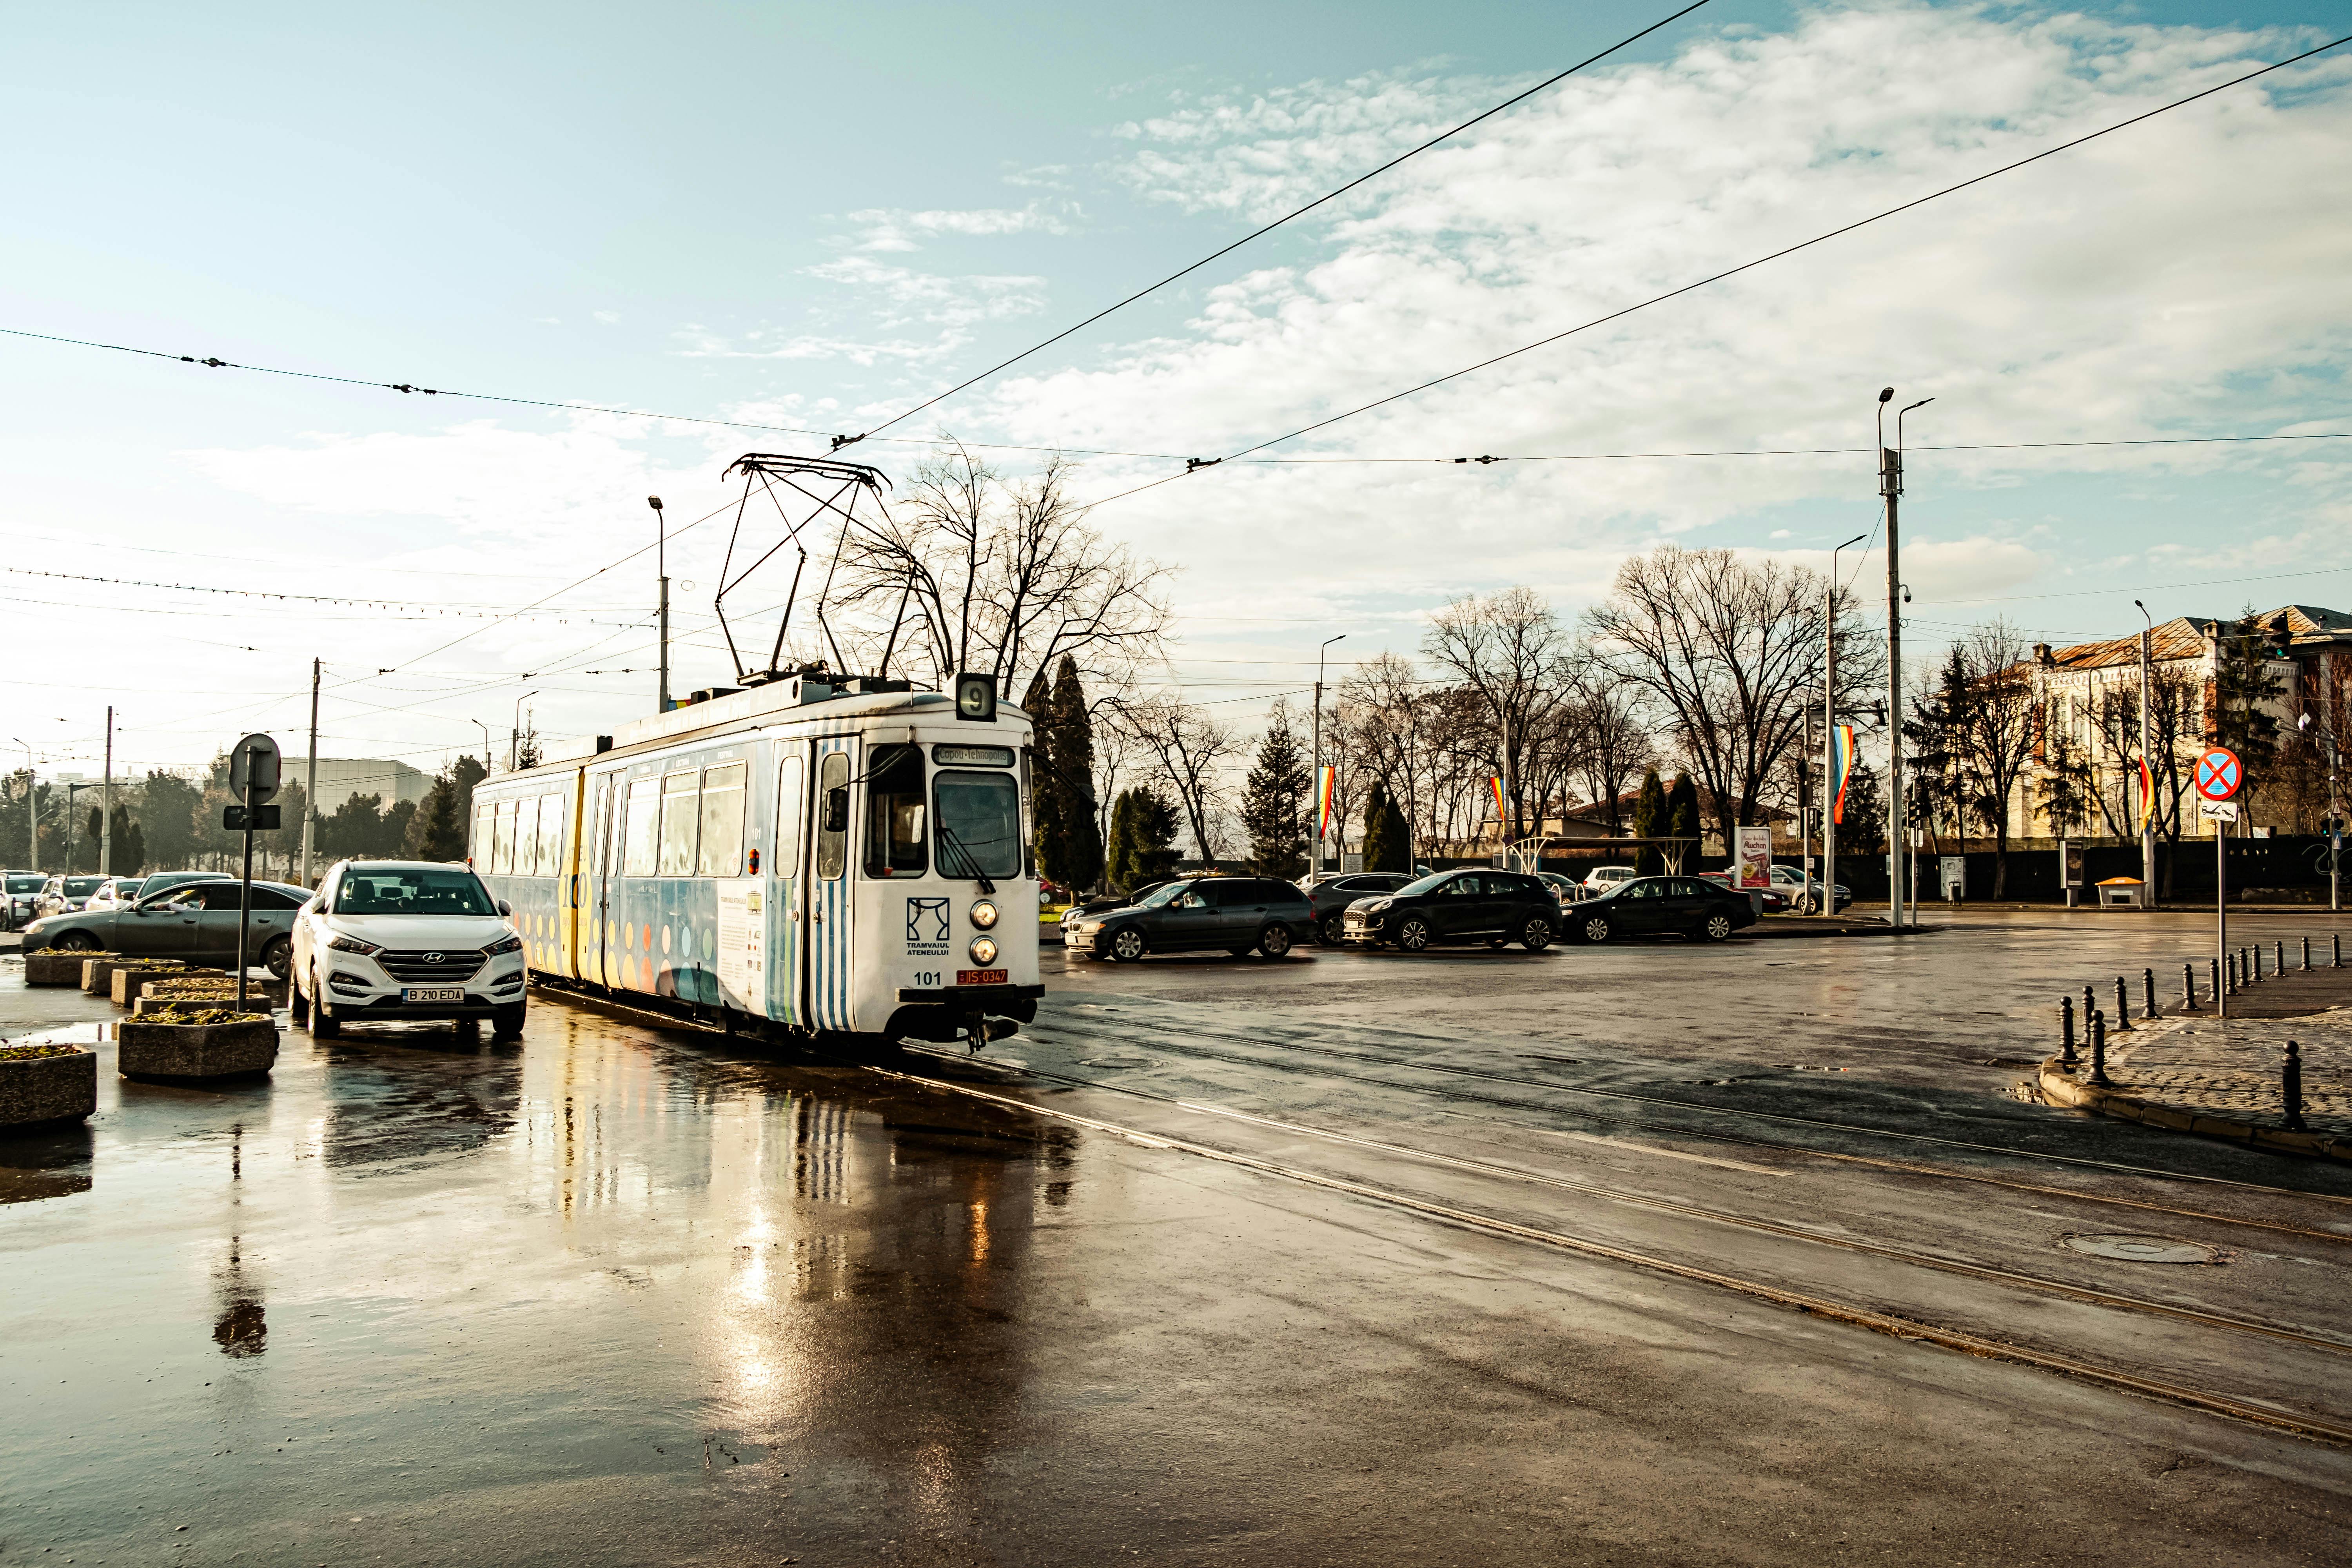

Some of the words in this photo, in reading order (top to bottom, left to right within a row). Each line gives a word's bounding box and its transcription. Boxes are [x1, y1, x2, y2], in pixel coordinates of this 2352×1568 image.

[970, 688, 982, 711] 9
[752, 827, 761, 840] 101
[1743, 840, 1766, 849] Auchan
[579, 917, 587, 931] 2019
[914, 971, 940, 985] 101
[410, 990, 417, 1000] B
[421, 990, 437, 1000] 210
[440, 990, 461, 1000] EDA
